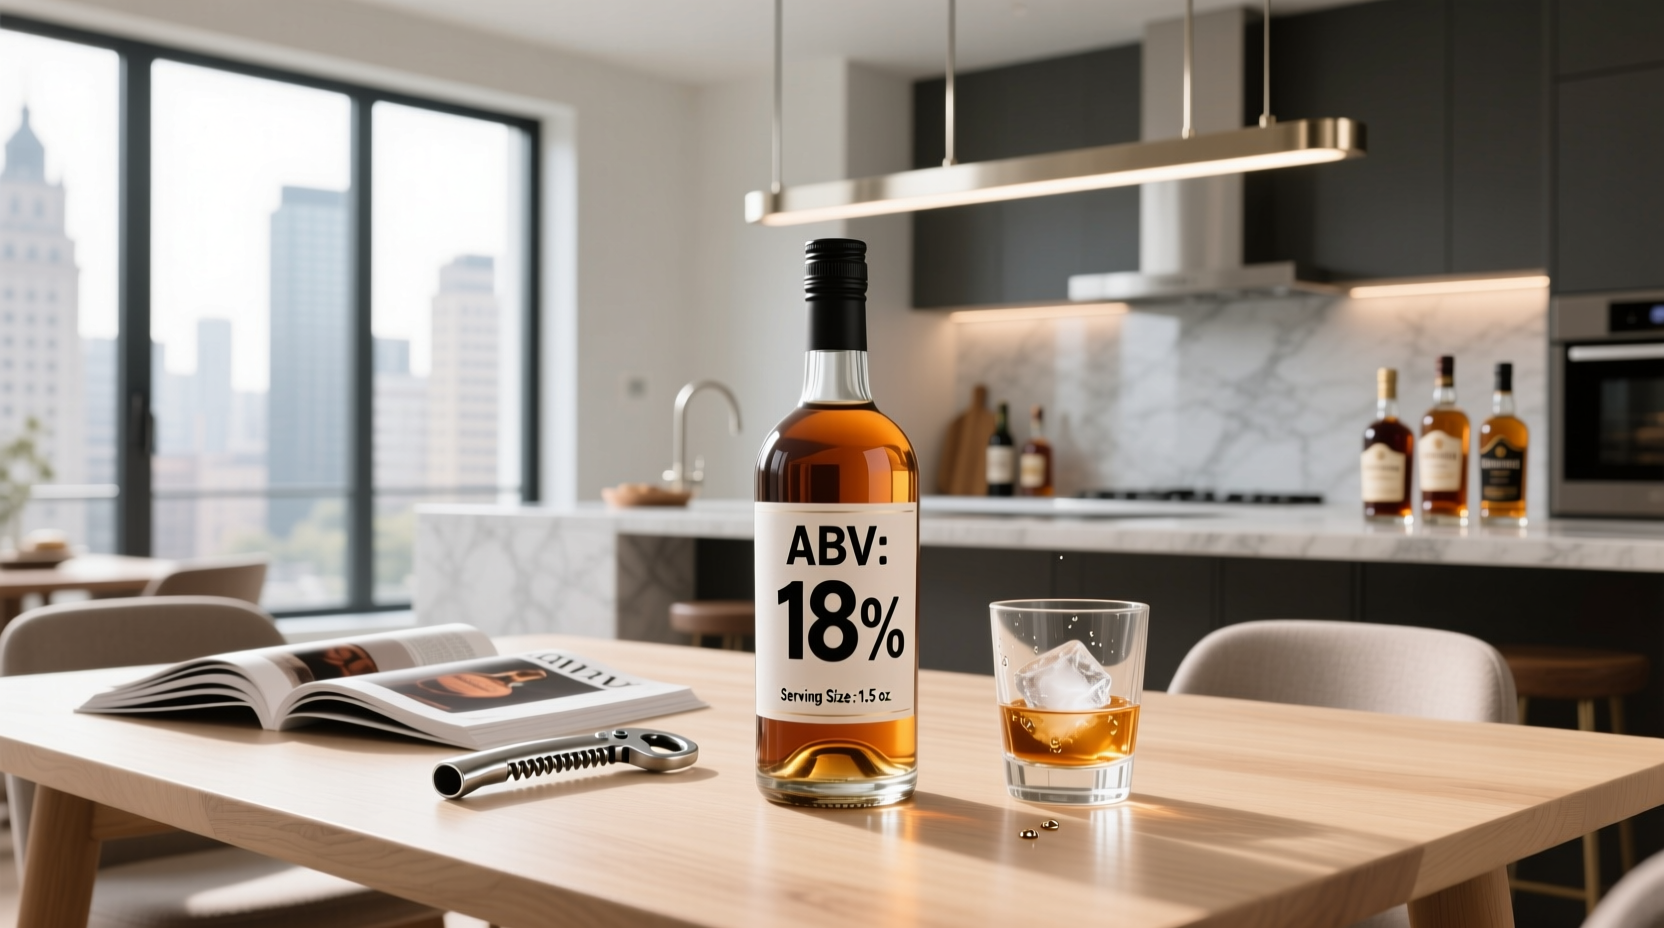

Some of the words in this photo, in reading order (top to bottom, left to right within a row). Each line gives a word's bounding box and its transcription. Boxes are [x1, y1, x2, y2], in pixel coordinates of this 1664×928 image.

[786, 525, 888, 566] ABV:
[777, 579, 905, 663] 18%
[780, 687, 823, 707] Serving
[858, 688, 877, 703] 1.5
[878, 691, 892, 702] oz
